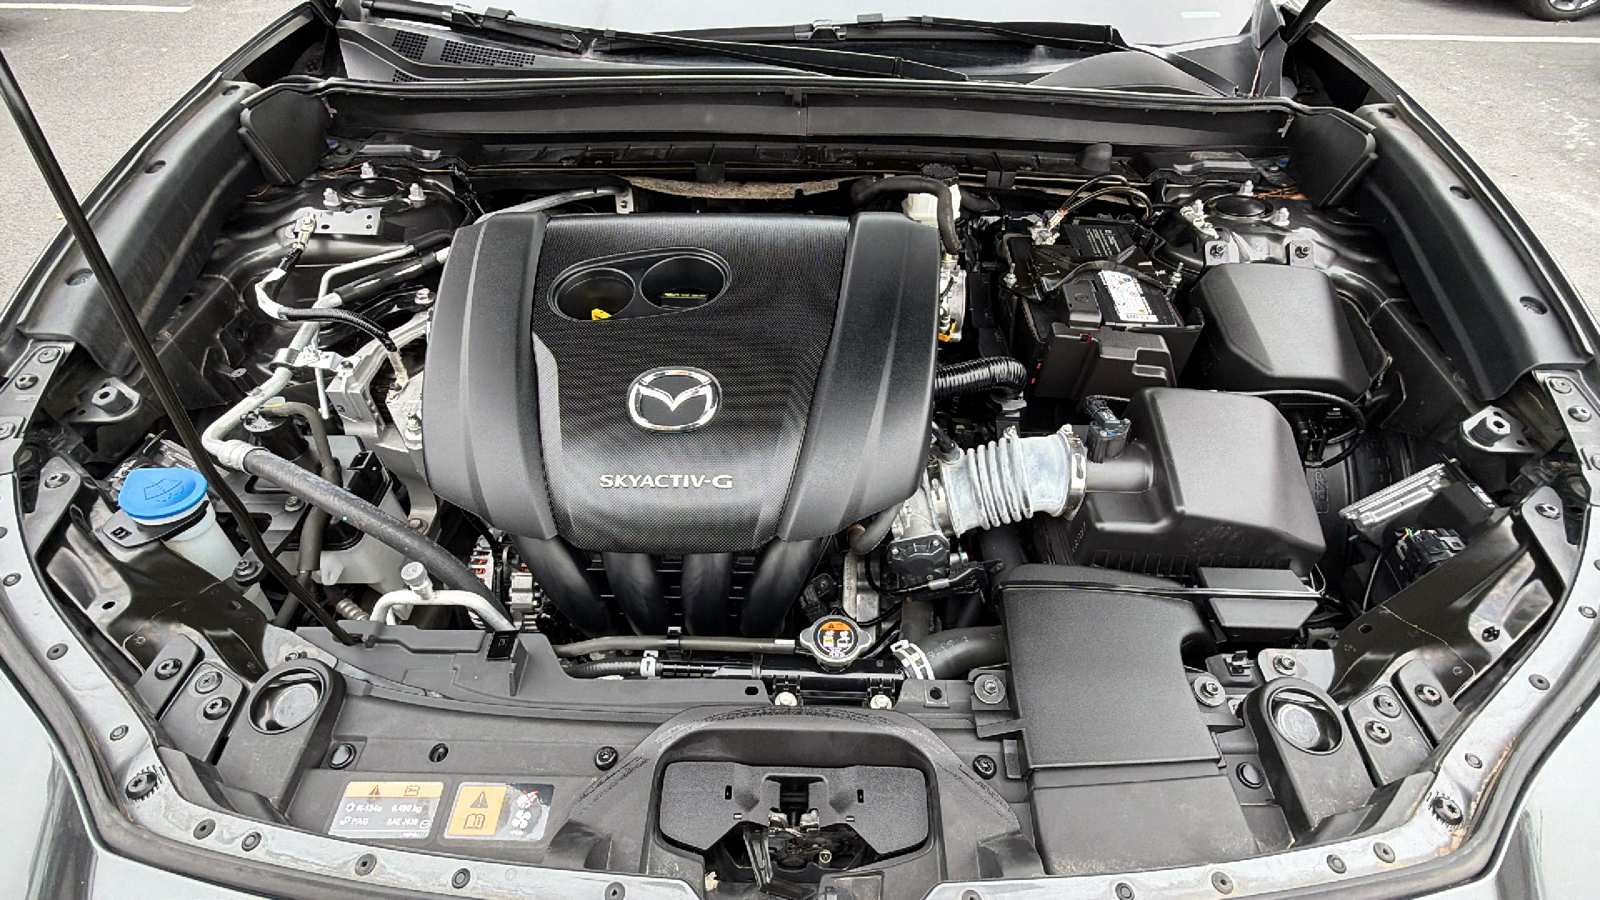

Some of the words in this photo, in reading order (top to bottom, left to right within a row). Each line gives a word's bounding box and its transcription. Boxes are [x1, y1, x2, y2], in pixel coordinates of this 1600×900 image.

[599, 474, 733, 489] SKYACTIV-G
[412, 804, 423, 814] kg
[351, 818, 370, 826] PAG
